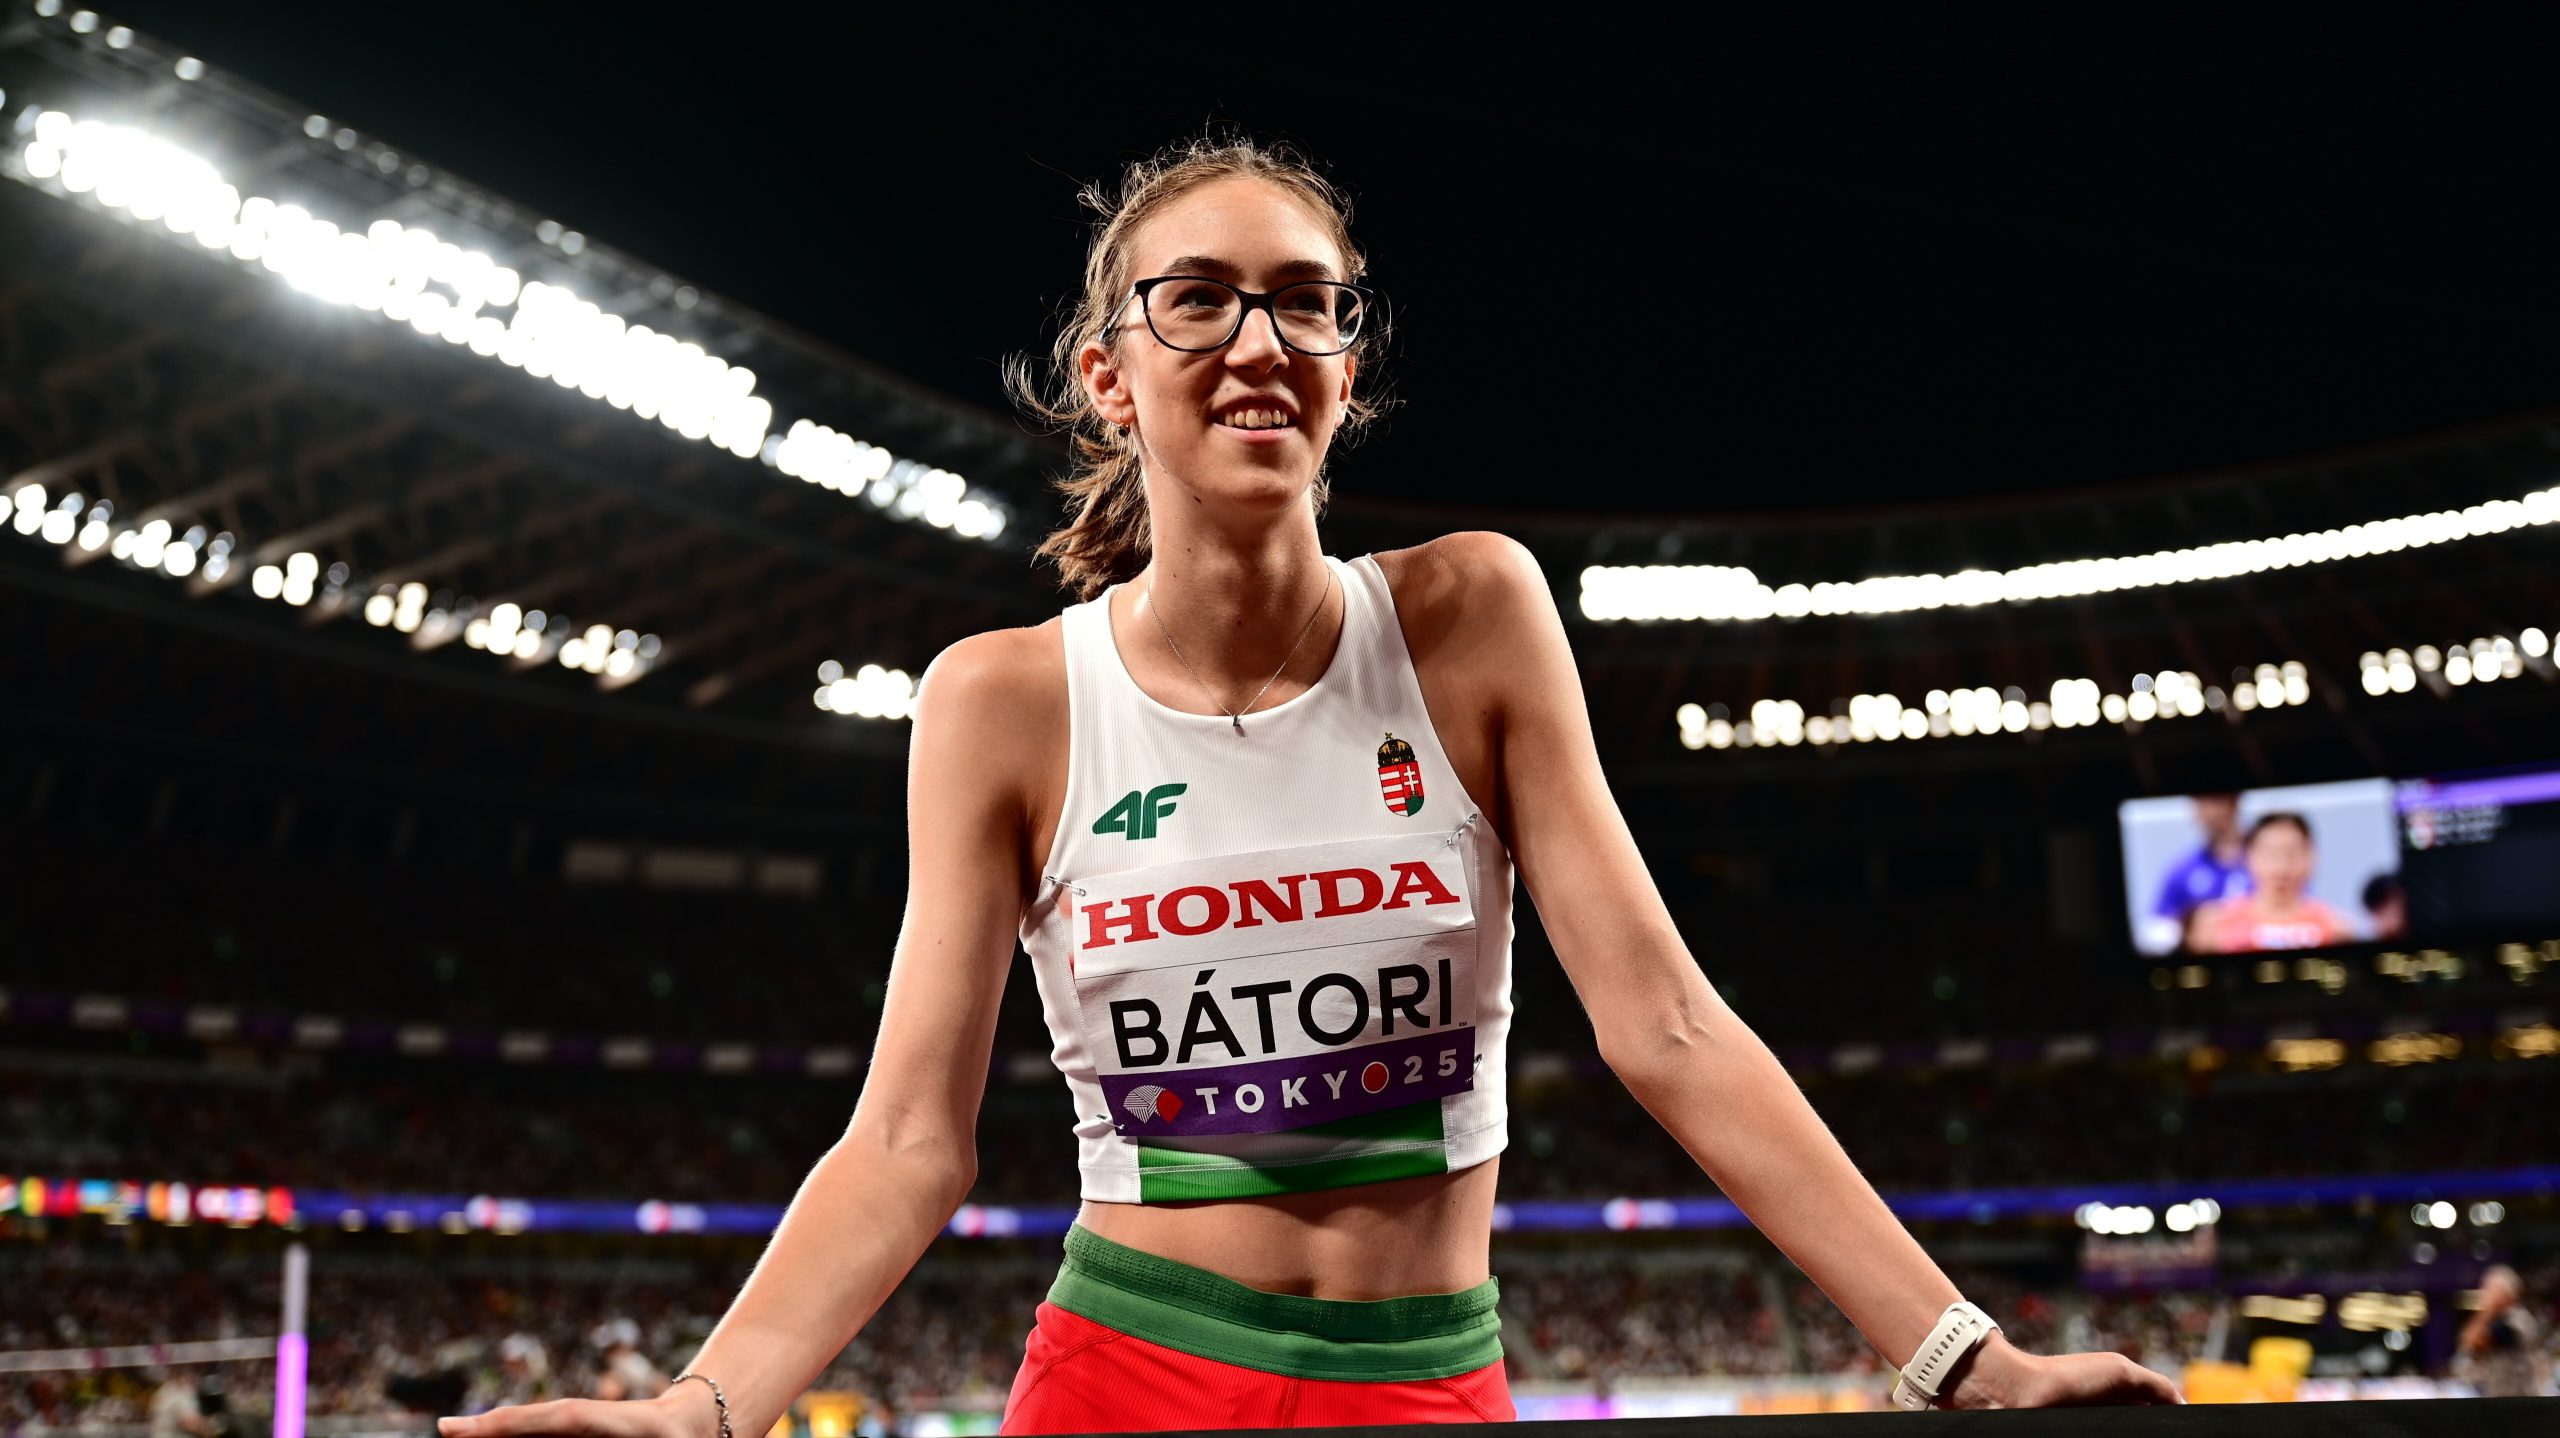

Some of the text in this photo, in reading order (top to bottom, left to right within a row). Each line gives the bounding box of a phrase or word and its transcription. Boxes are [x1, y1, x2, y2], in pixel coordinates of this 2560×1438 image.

[1092, 783, 1187, 840] 4F
[1081, 861, 1460, 949] HONDA
[1109, 958, 1452, 1069] BÁTORI
